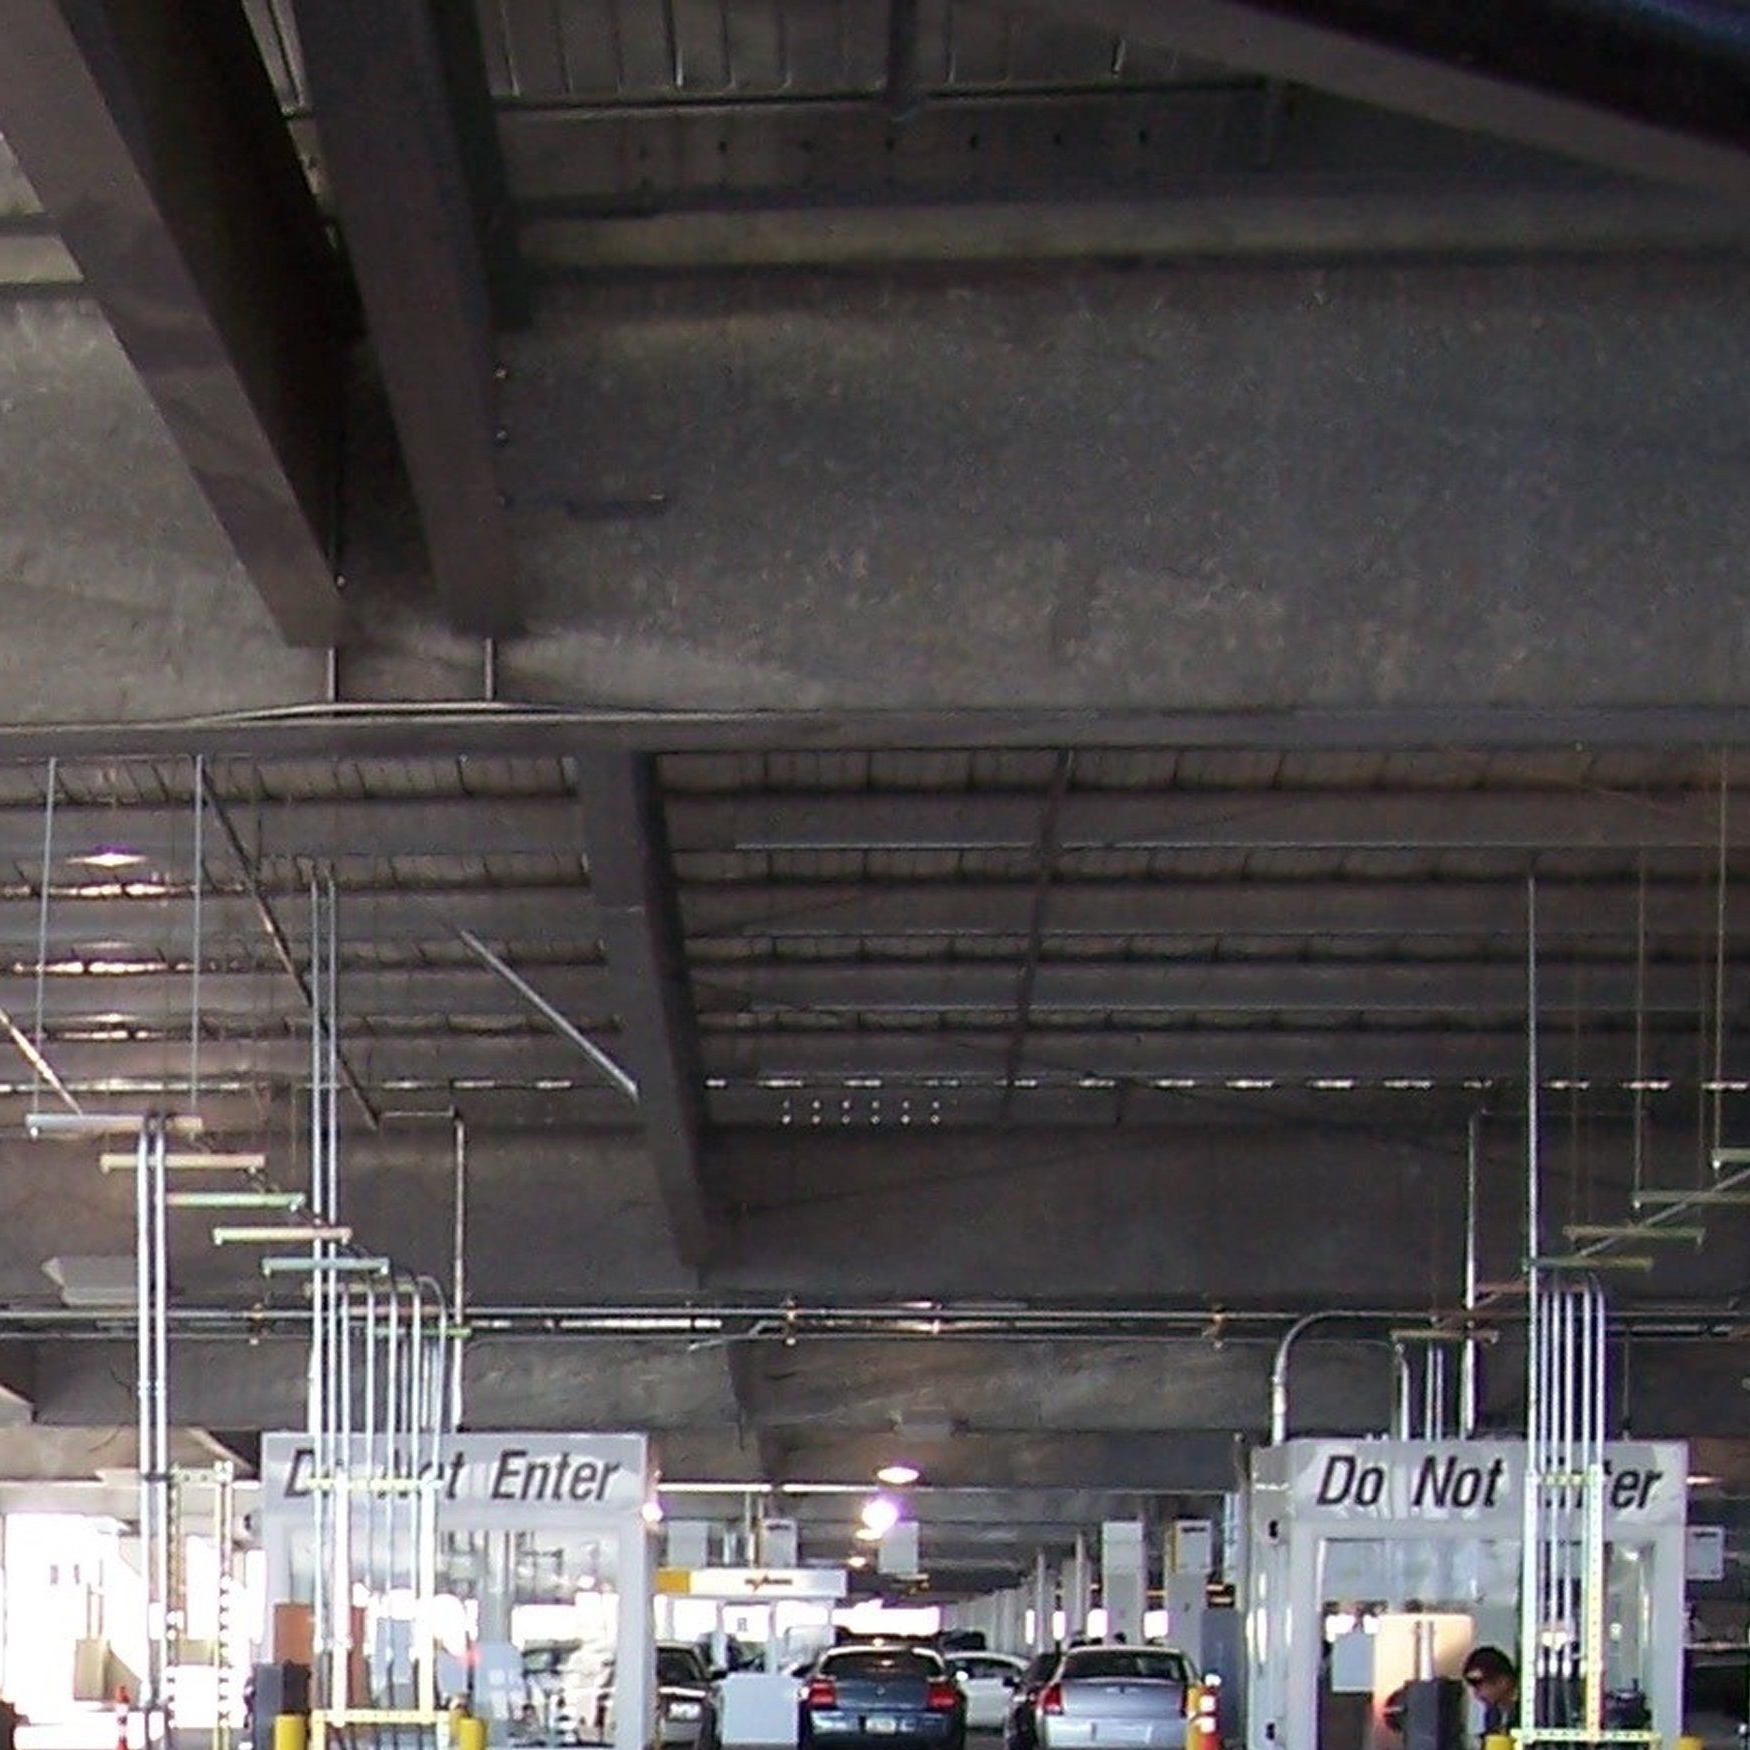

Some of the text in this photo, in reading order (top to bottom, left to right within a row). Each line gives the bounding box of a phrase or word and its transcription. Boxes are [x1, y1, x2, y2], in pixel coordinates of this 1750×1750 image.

[490, 1447, 621, 1501] Enter
[1315, 1454, 1385, 1508] Do
[1411, 1454, 1504, 1508] Not
